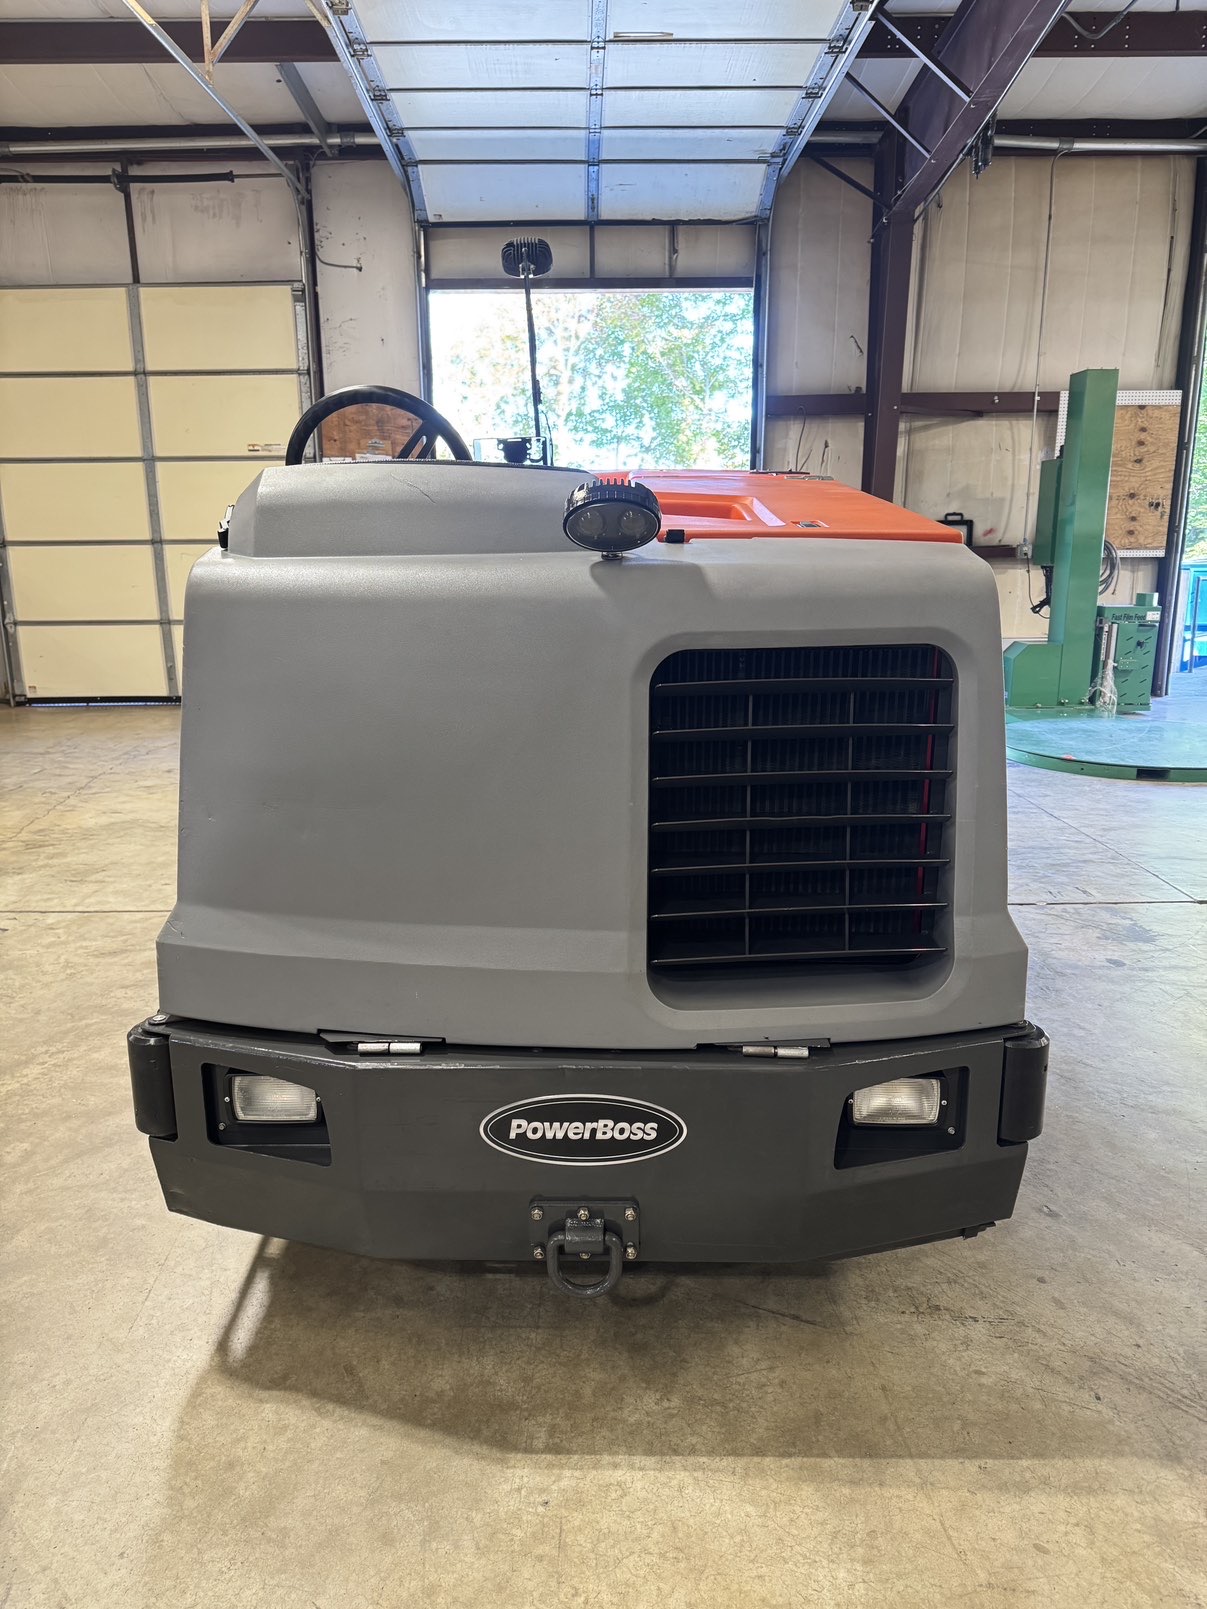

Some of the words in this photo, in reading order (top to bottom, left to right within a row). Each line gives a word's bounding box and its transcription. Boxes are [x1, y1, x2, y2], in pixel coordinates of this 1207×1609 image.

[1111, 613, 1123, 621] Fast
[1123, 613, 1134, 621] Film
[1134, 613, 1146, 621] Feed
[509, 1118, 658, 1141] PowerBoss
